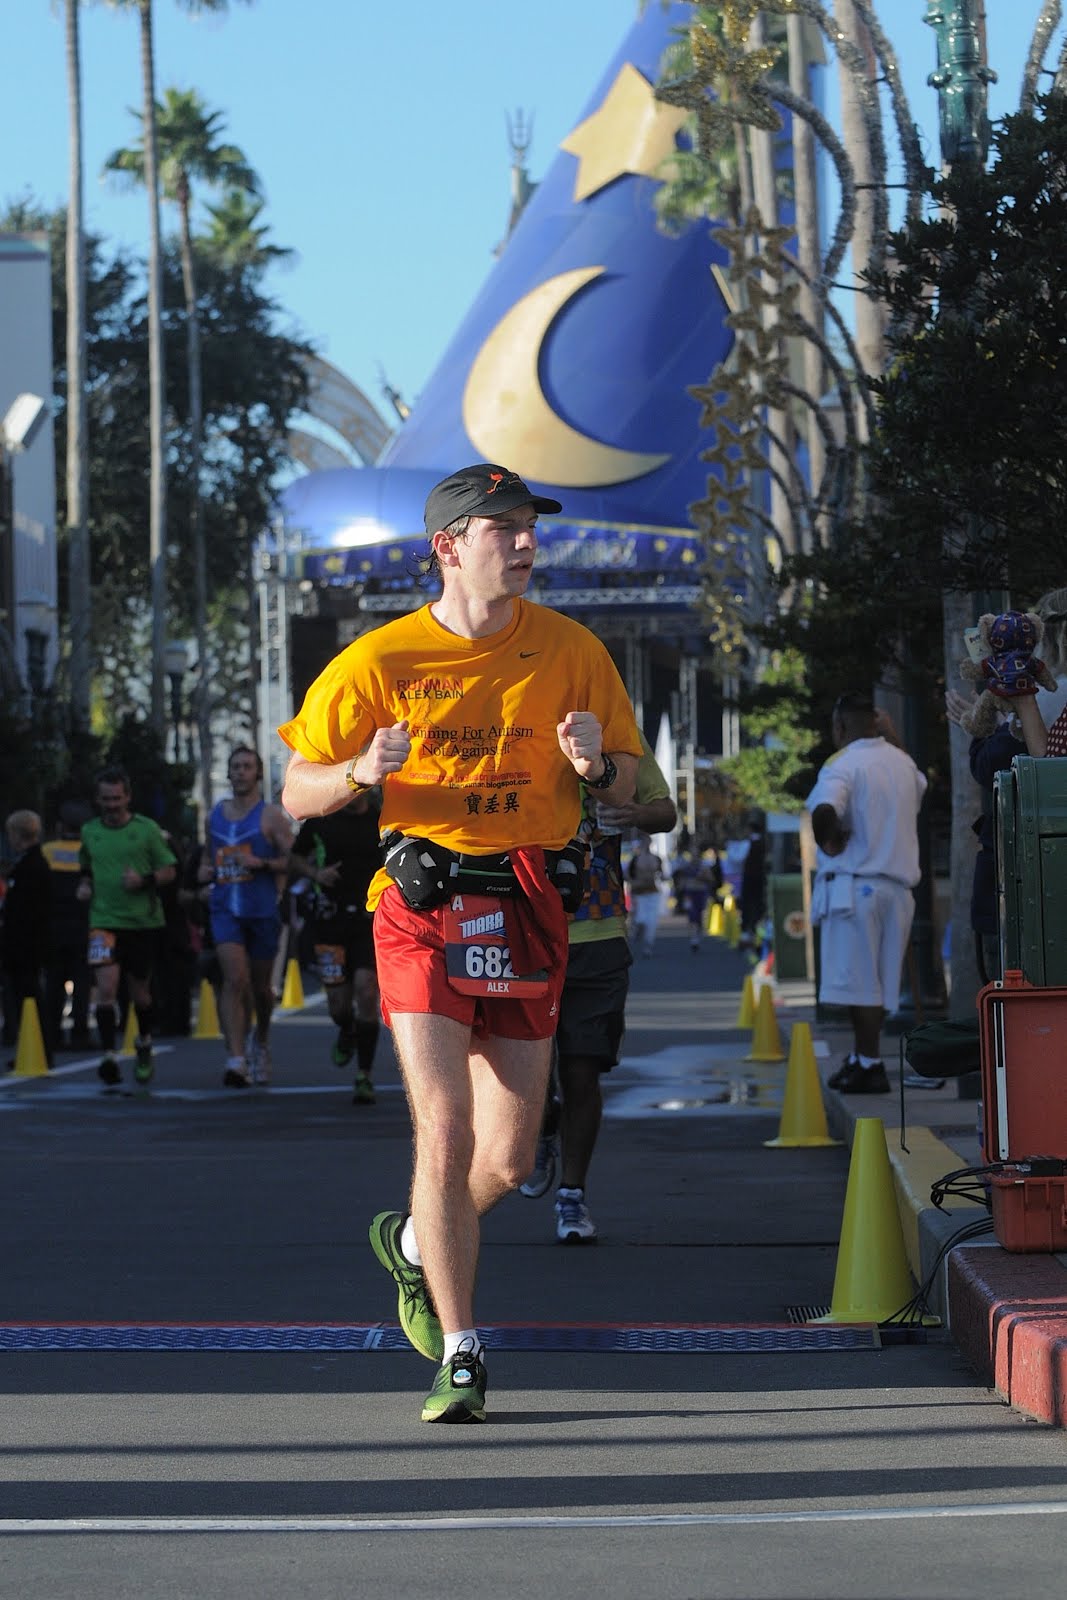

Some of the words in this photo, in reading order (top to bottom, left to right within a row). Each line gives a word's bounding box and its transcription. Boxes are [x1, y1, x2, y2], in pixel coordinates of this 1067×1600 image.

[396, 678, 464, 691] RUNMAN
[398, 690, 431, 700] ALEX
[434, 690, 464, 700] BAIN
[411, 725, 458, 742] unning
[463, 726, 484, 739] For
[488, 724, 533, 738] Autism
[422, 743, 445, 757] Not
[452, 895, 464, 911] A
[487, 982, 509, 993] ALEX
